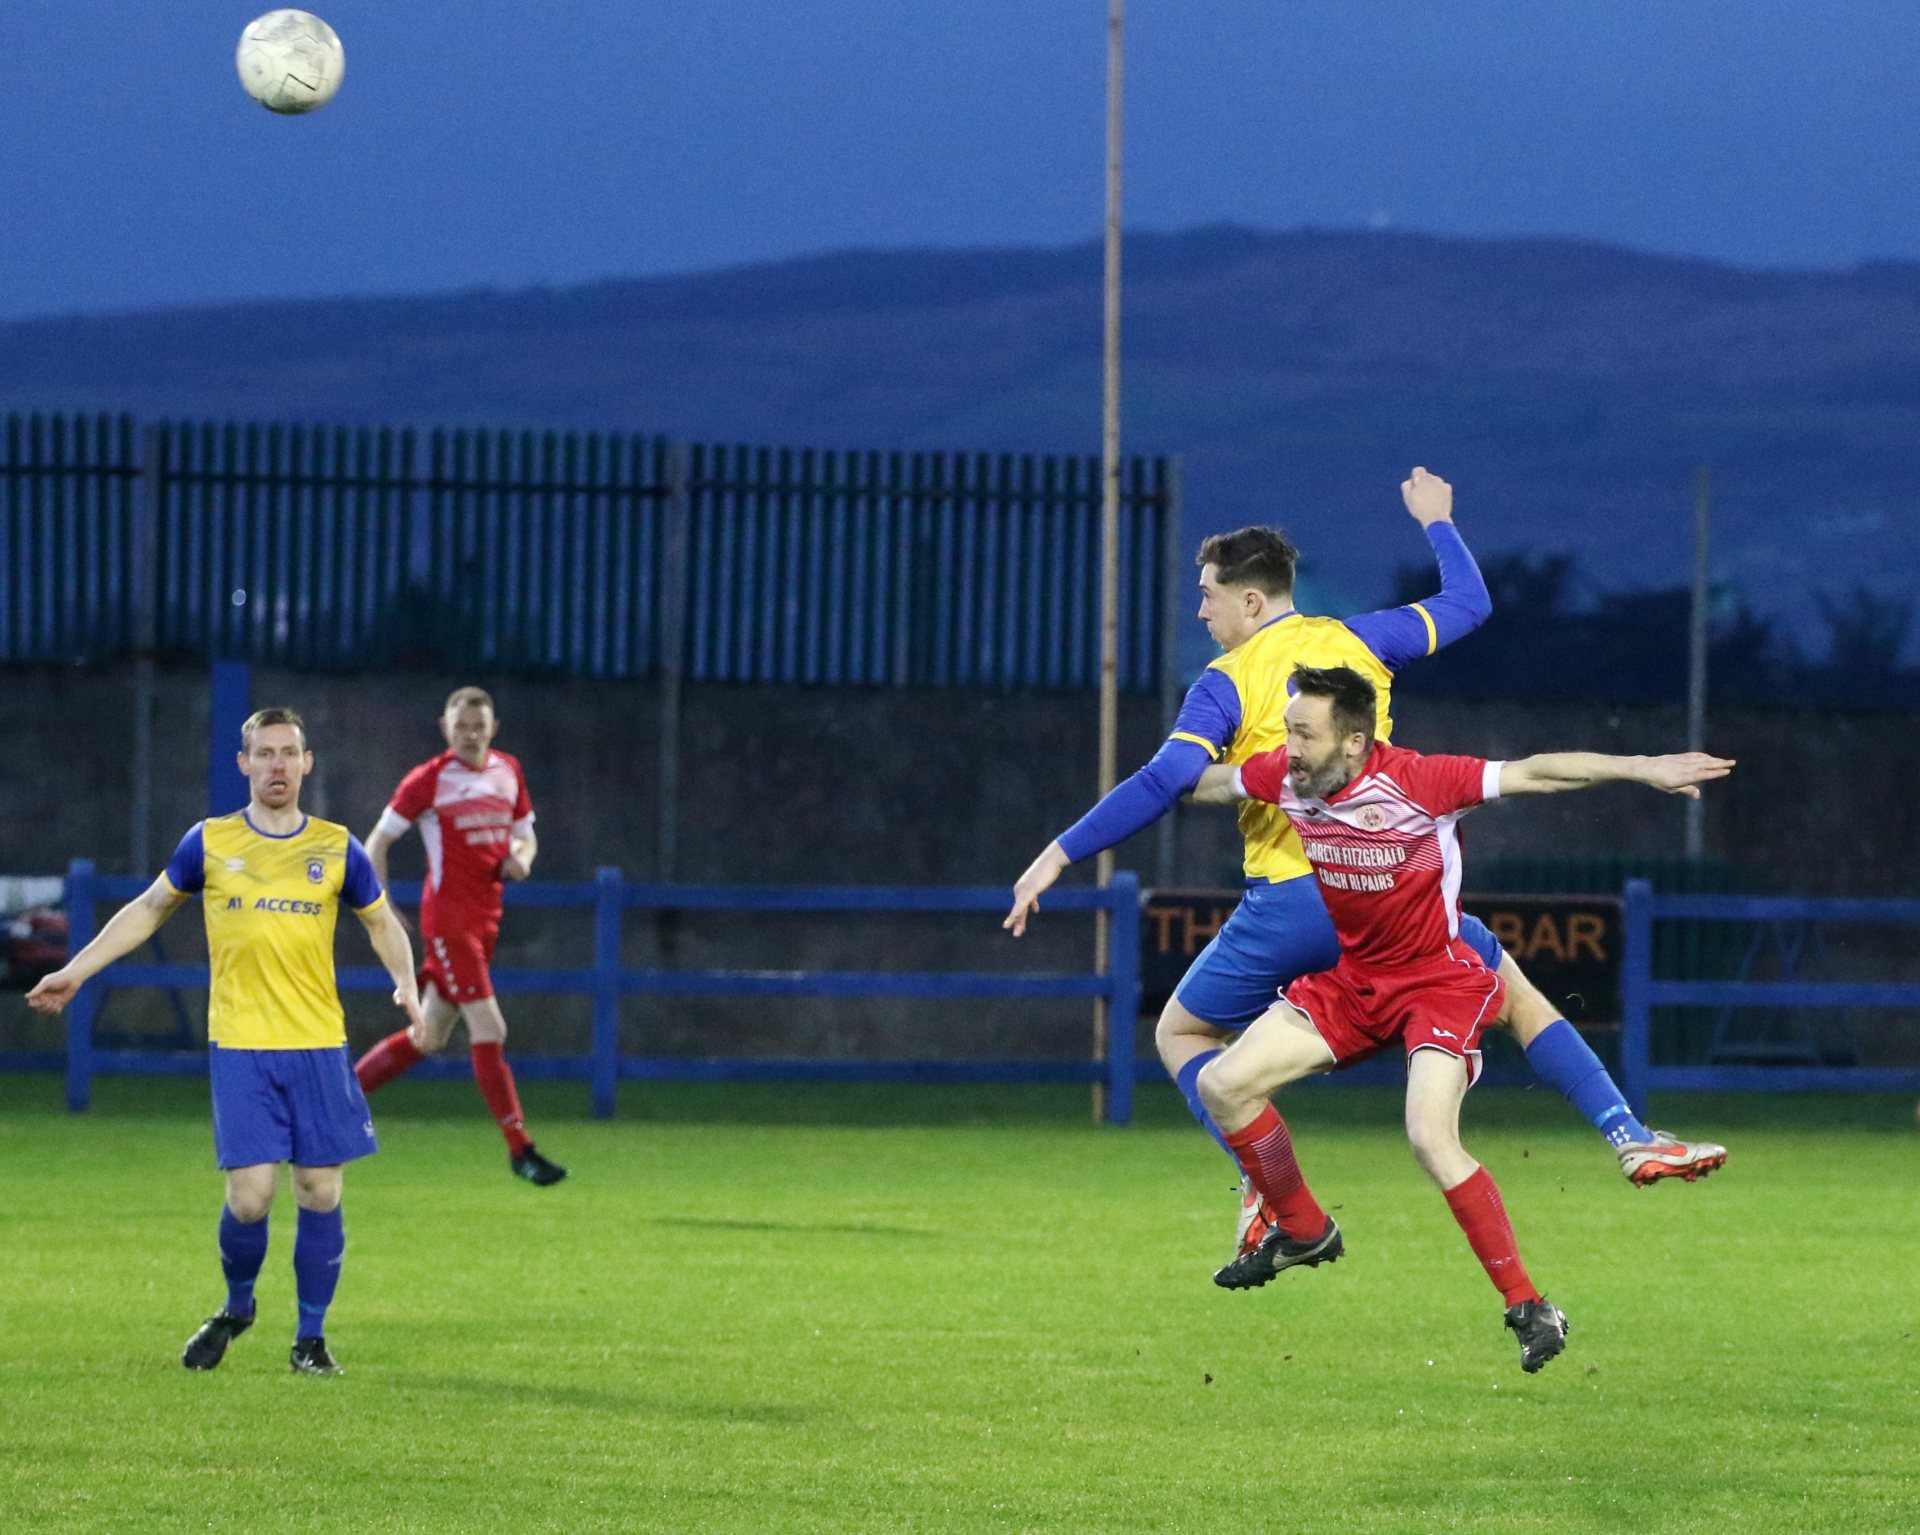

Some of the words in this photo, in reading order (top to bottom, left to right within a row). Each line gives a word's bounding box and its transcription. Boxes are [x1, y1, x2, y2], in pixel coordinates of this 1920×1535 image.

[1319, 867, 1348, 890] CRASH
[254, 897, 322, 916] ACCESS
[1147, 906, 1234, 955] TH
[1490, 911, 1608, 962] BAR
